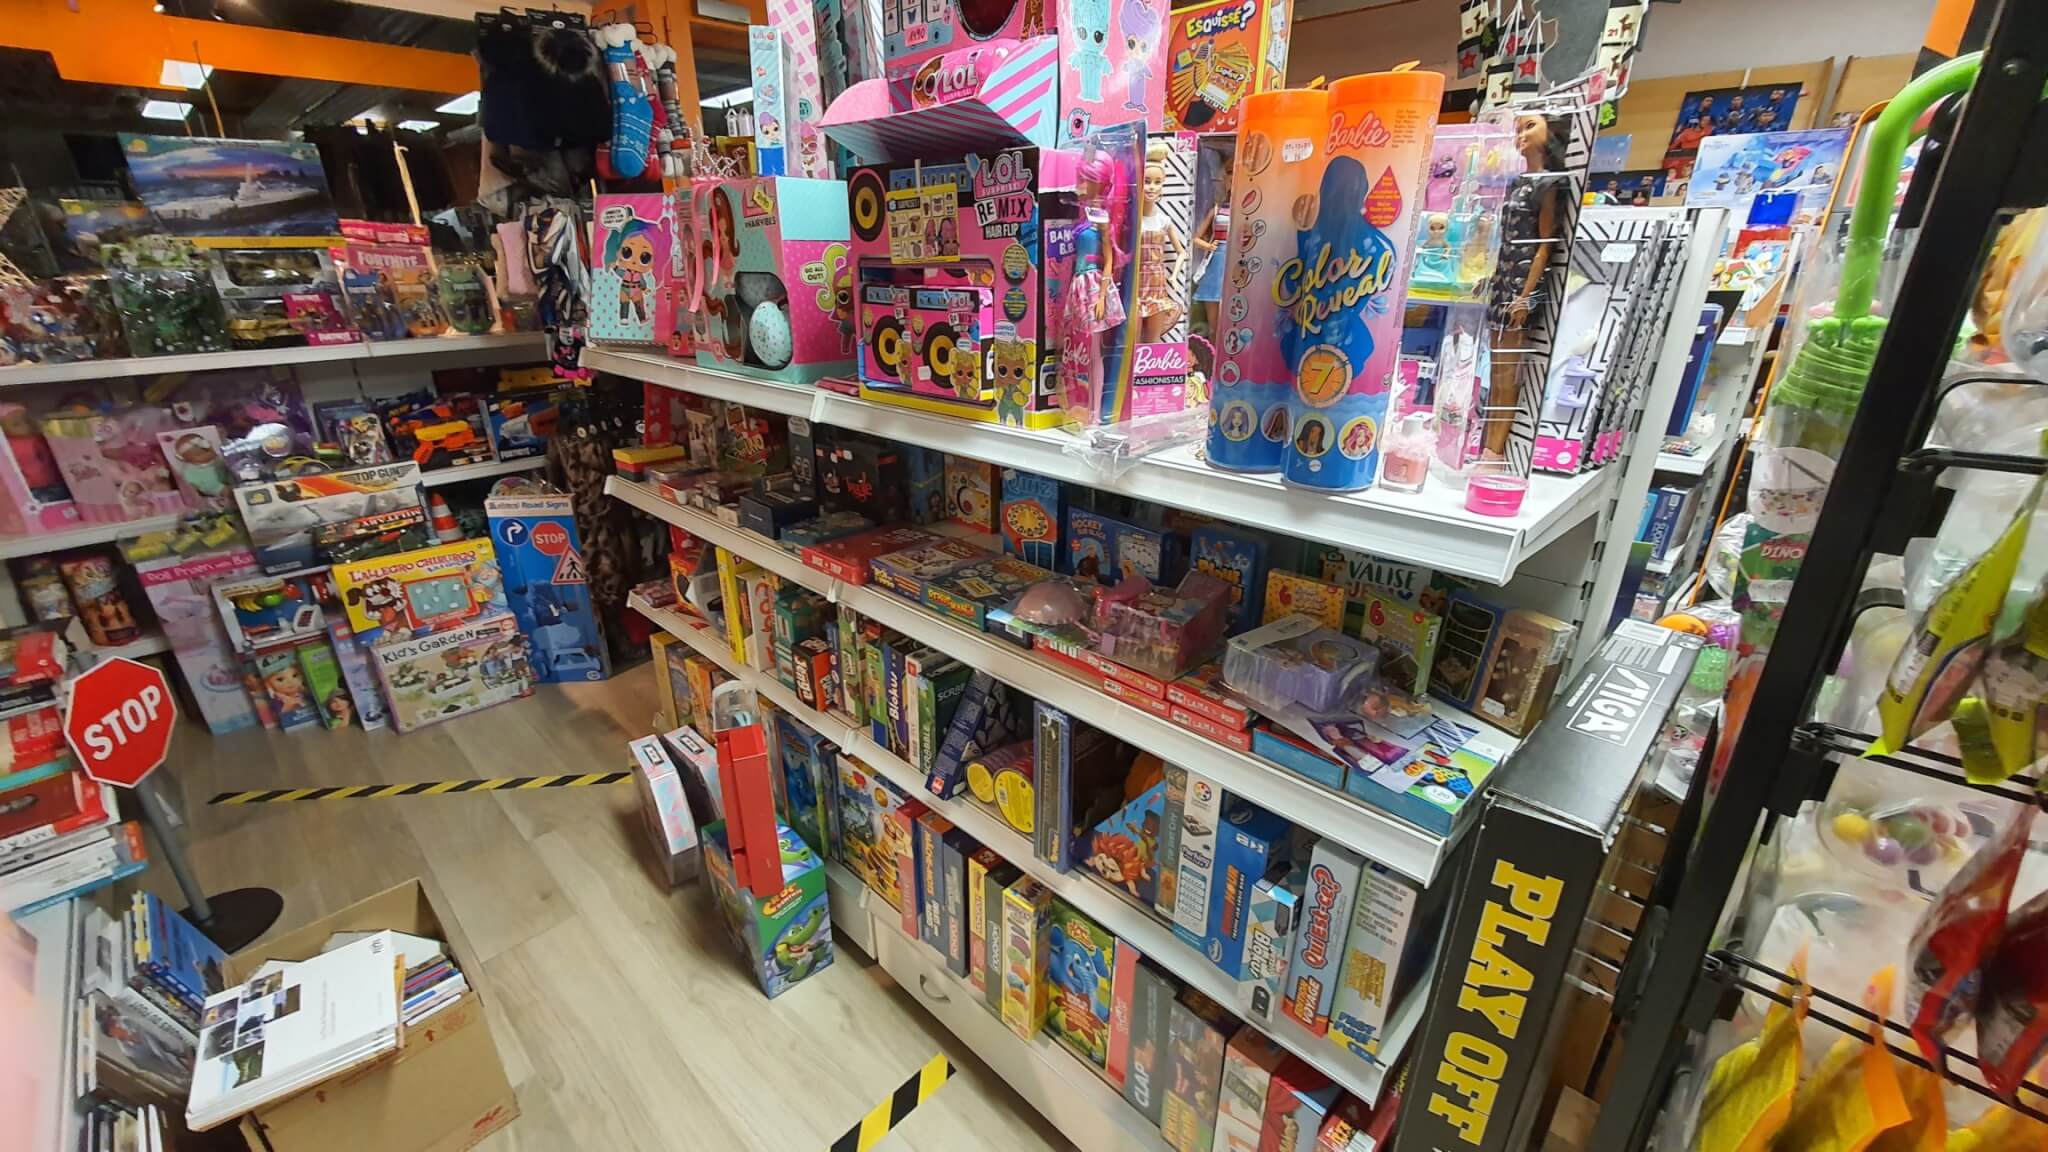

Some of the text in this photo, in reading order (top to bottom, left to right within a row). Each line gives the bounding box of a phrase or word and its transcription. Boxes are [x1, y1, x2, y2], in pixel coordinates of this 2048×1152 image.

[941, 64, 978, 92] LOL
[1326, 110, 1391, 156] Barbie
[981, 151, 1031, 187] LOL
[984, 222, 1020, 239] HAIR FLIP
[1049, 227, 1074, 243] BAN
[357, 250, 418, 267] FORTNITE
[1271, 242, 1372, 306] Color
[1297, 248, 1393, 340] Reveal
[1133, 345, 1186, 374] Barbie
[1135, 375, 1185, 386] ASHIONISTAS
[1307, 362, 1335, 395] 7
[354, 466, 400, 482] TOP GUN
[521, 501, 544, 510] Road
[545, 500, 569, 512] Signs
[535, 532, 566, 545] STOP
[1761, 545, 1802, 560] DINO
[348, 550, 477, 583] L'ALLEGRO CHIRURGO
[1349, 559, 1417, 592] VALISE
[1278, 584, 1293, 606] 6
[1368, 600, 1385, 626] 6
[794, 656, 813, 702] Jenga
[83, 684, 162, 762] STOP
[1301, 976, 1321, 1025] VOYAGE
[1427, 858, 1565, 1146] PLAY OFF
[1134, 1062, 1150, 1107] CLAP
